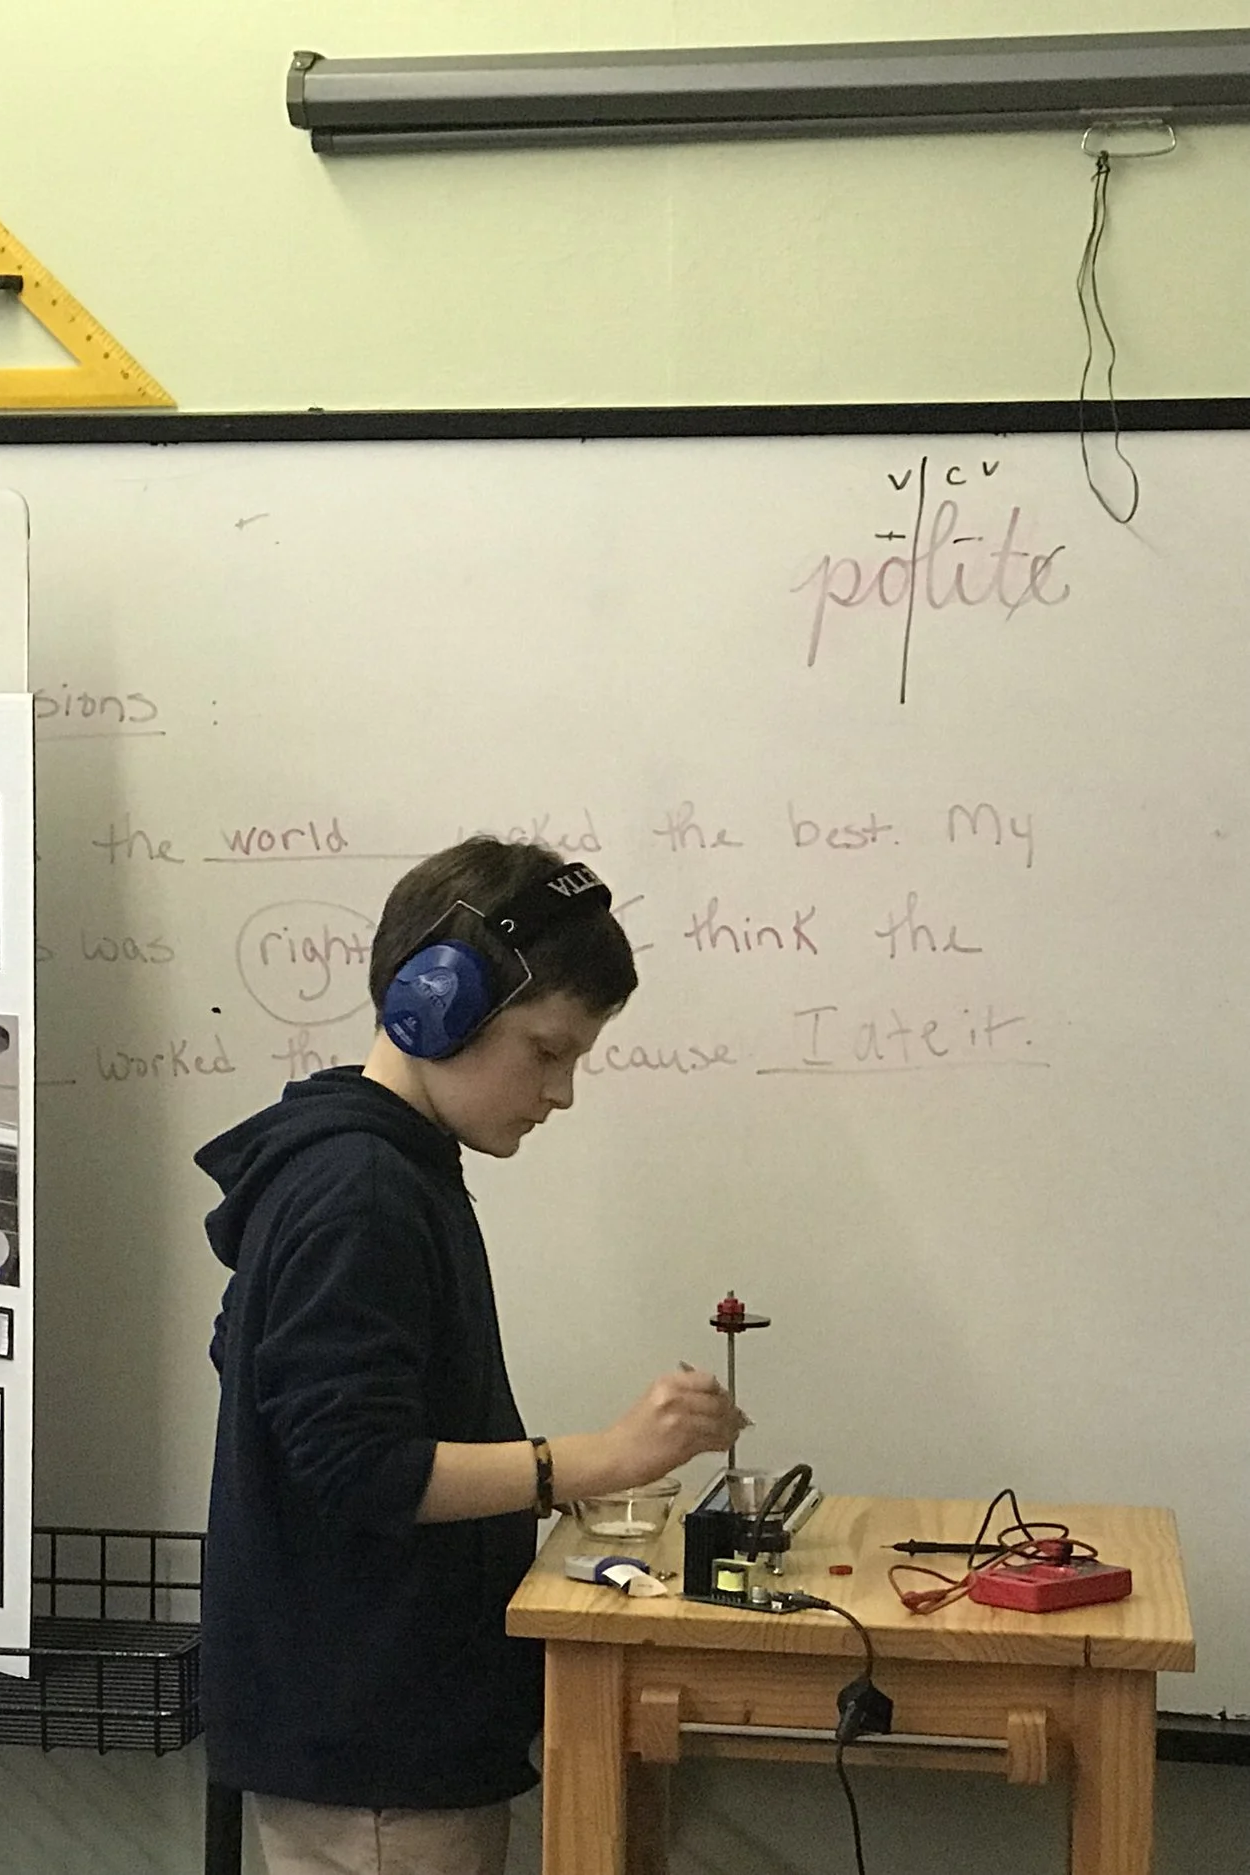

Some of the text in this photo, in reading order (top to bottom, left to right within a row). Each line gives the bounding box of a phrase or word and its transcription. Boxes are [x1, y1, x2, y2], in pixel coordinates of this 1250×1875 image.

[93, 812, 184, 864] the
[222, 817, 349, 856] world
[653, 801, 742, 851] the
[787, 800, 900, 849] best.
[948, 803, 1034, 867] My
[260, 924, 373, 1000] right
[683, 896, 818, 955] think
[875, 891, 982, 958] the
[96, 1034, 236, 1081] worked
[794, 1006, 838, 1066] I
